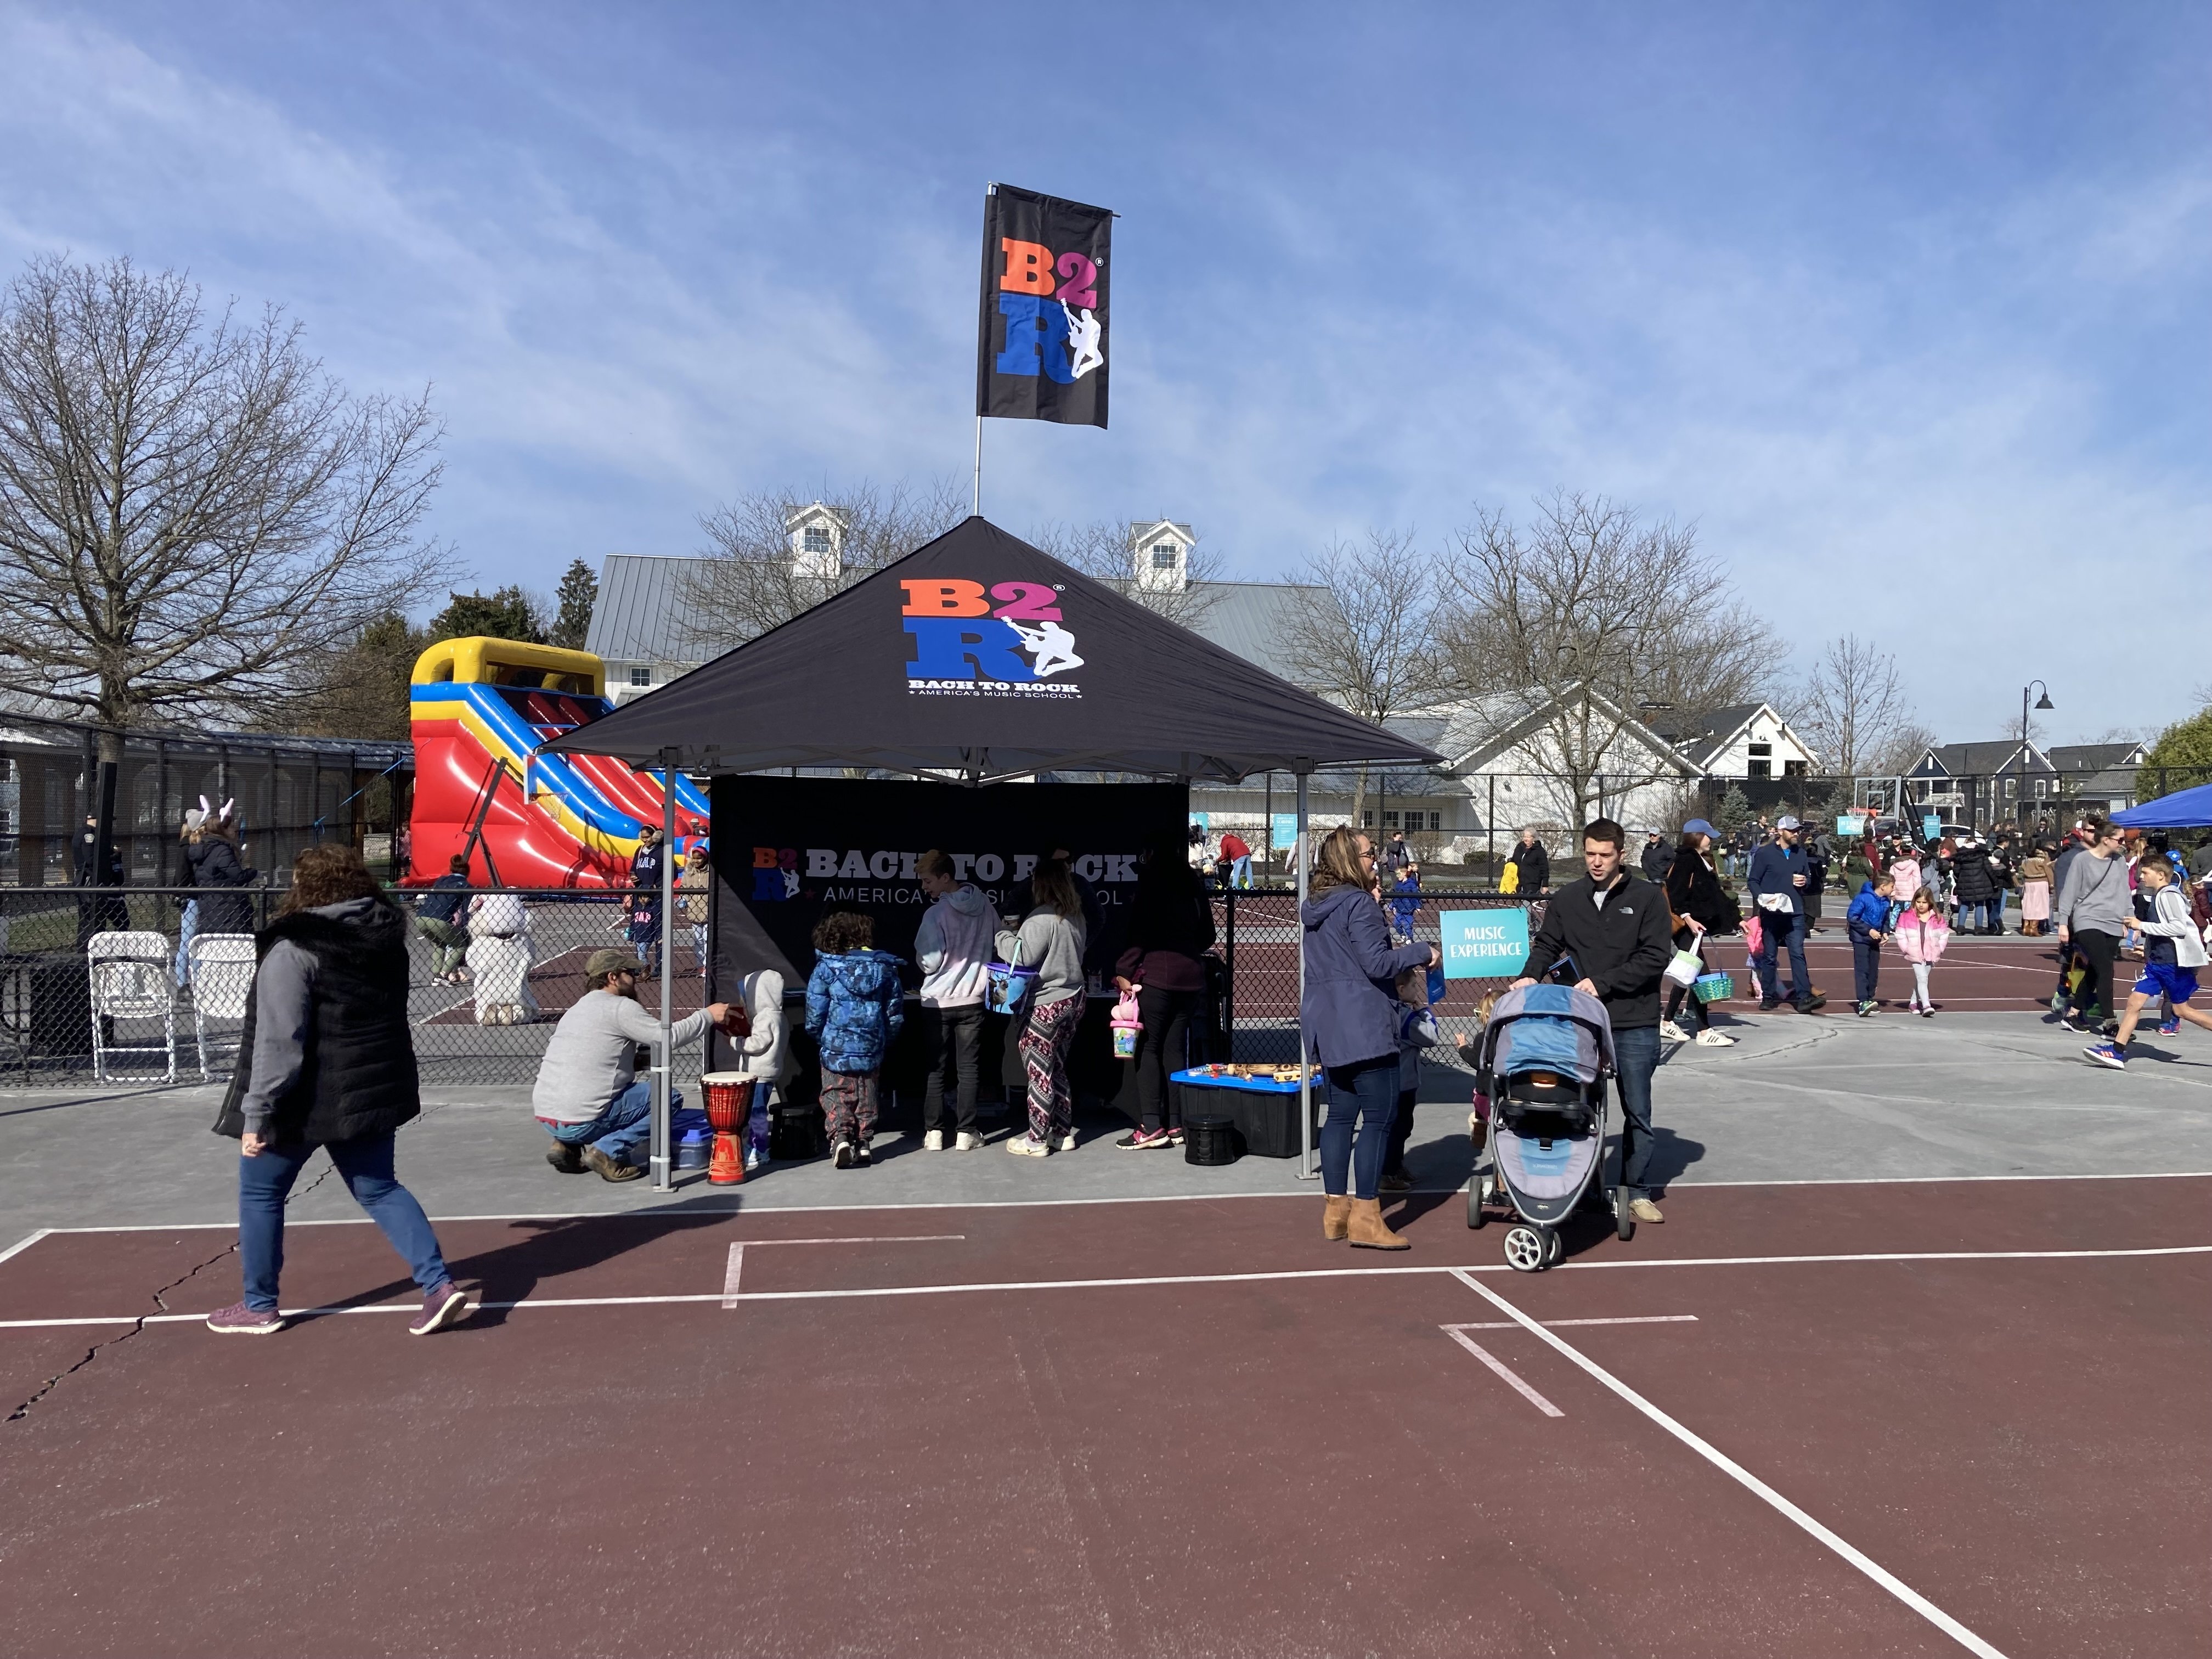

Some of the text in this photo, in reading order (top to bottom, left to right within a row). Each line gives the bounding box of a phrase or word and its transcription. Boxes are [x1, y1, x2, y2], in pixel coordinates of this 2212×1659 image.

[997, 292, 1076, 384] R
[902, 617, 1044, 682] R
[908, 680, 1080, 693] BACH TO ROCK
[951, 854, 1005, 882] TO
[1013, 854, 1138, 882] RCK
[1464, 926, 1506, 941] MUSIC
[1450, 942, 1523, 958] EXPERIENCE
